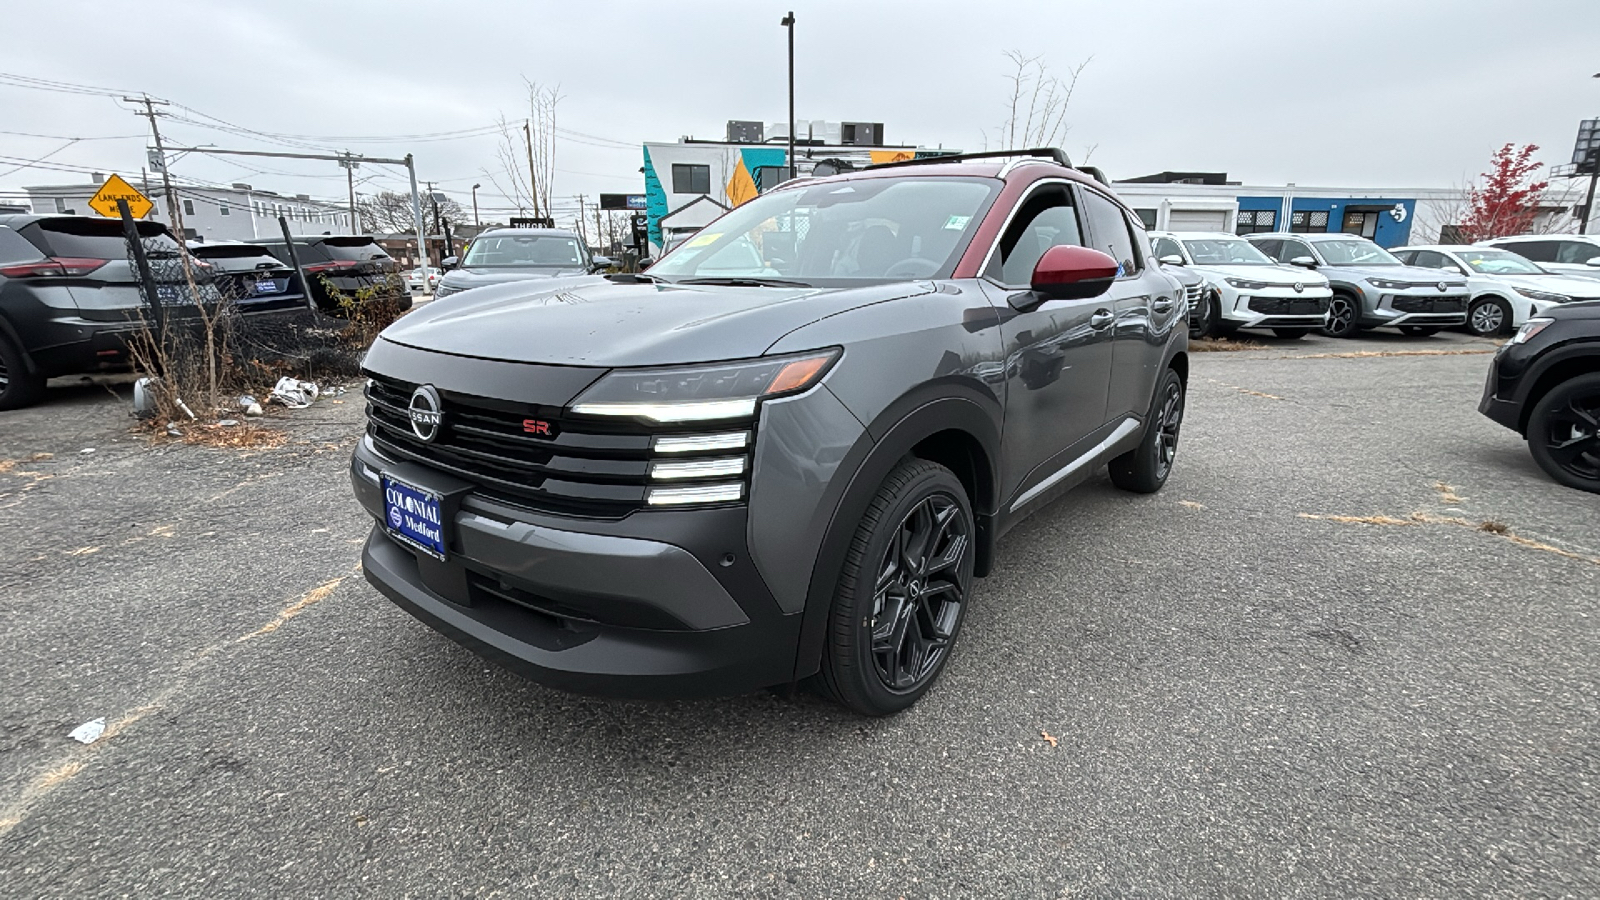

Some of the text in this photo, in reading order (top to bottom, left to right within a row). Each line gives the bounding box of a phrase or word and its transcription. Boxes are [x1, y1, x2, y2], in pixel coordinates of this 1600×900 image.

[98, 194, 142, 203] LANE ENDS
[109, 205, 136, 214] MEE
[522, 419, 550, 436] SR
[386, 487, 441, 526] COLONIAL
[405, 514, 441, 543] Medford
